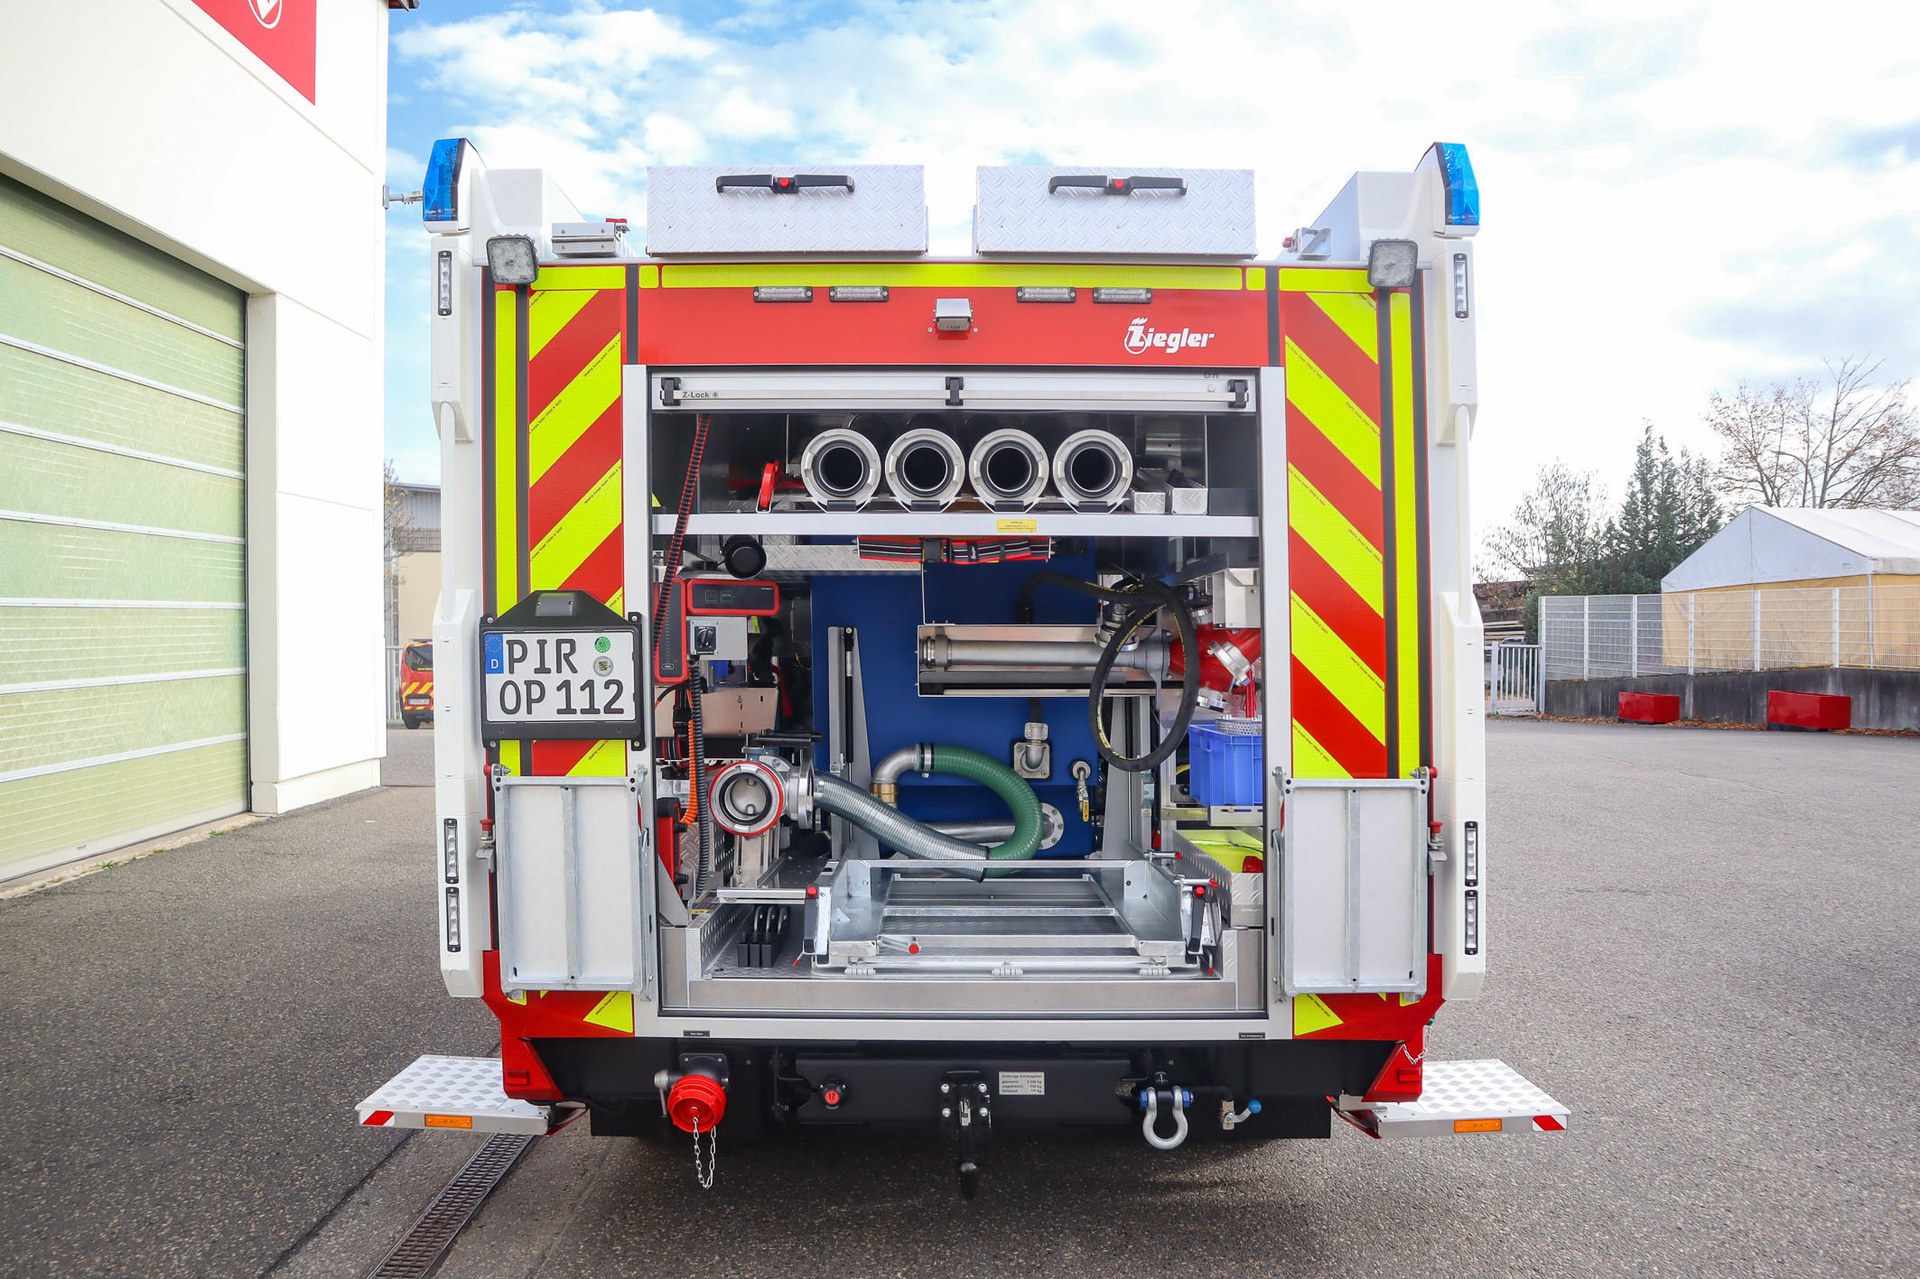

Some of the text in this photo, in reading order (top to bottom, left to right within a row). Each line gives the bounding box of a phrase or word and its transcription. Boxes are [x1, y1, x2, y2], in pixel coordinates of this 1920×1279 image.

[1124, 317, 1215, 354] Ziegler
[491, 659, 499, 669] D
[506, 639, 578, 674] PIR
[500, 679, 624, 715] OP 112
